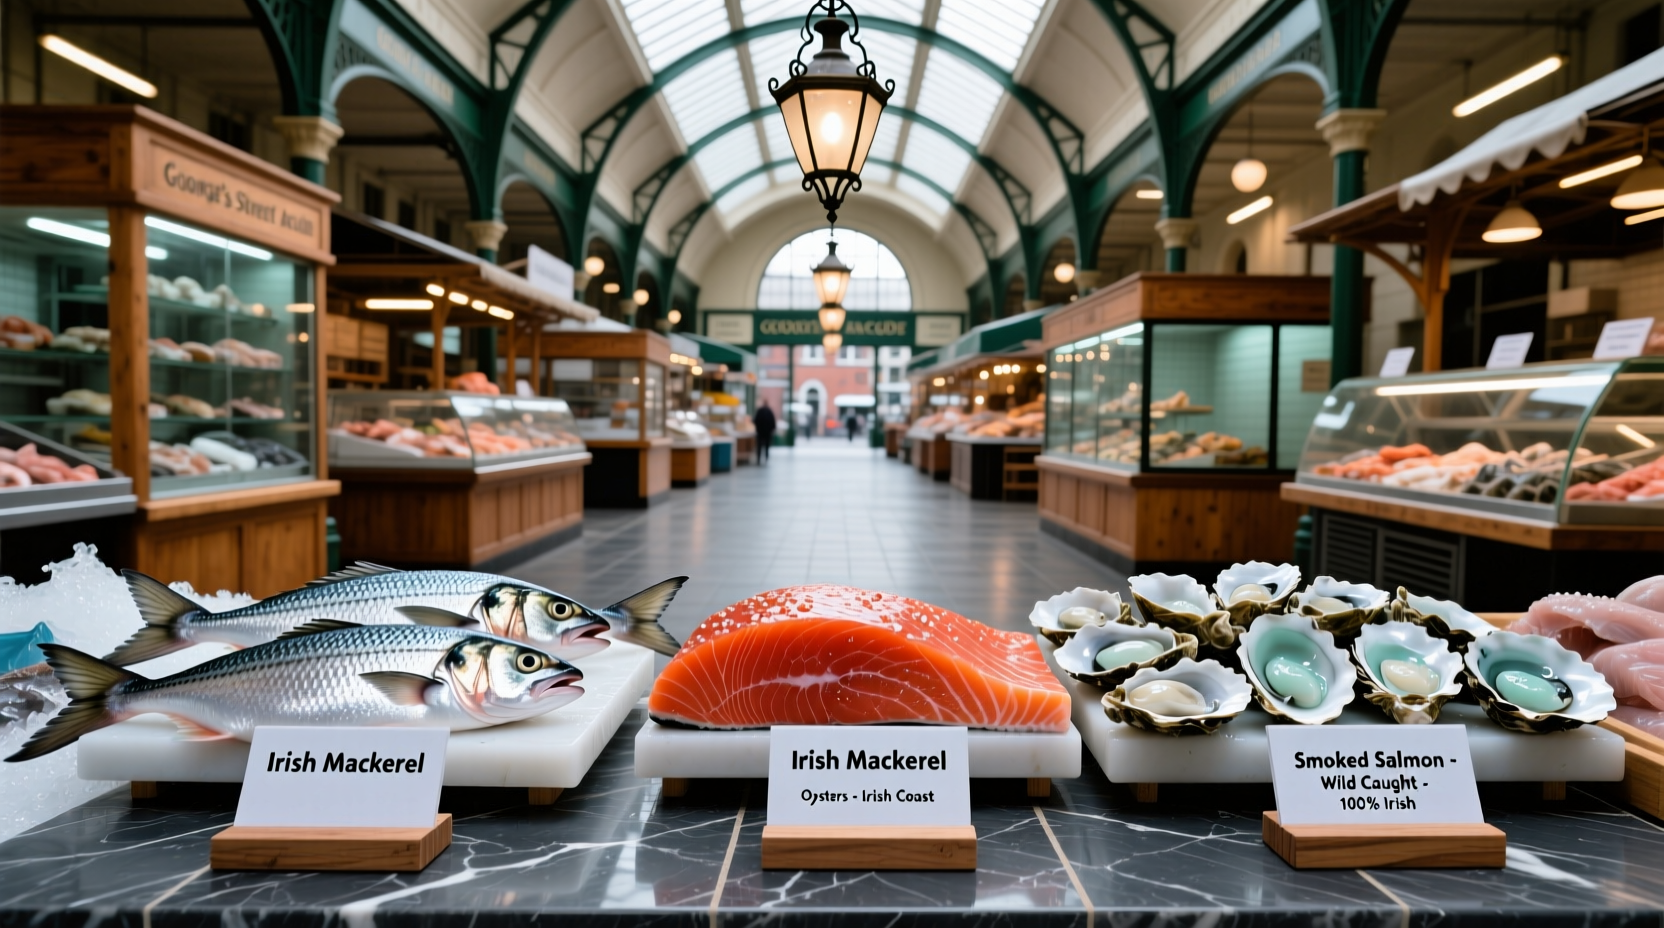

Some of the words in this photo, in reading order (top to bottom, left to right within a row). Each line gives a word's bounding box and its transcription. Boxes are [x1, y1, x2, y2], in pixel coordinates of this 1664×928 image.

[266, 750, 317, 773] Irish
[322, 751, 425, 774] Mackerel
[792, 749, 840, 770] Irish
[846, 749, 947, 771] Mackerel
[1294, 750, 1369, 769] Smoked
[1374, 750, 1445, 769] Salmon
[1320, 774, 1357, 790] Wild
[1360, 773, 1418, 794] Caught
[862, 788, 892, 802] Irish
[895, 788, 935, 803] Coast
[1339, 796, 1380, 811] 100%
[1383, 795, 1417, 811] Irish
